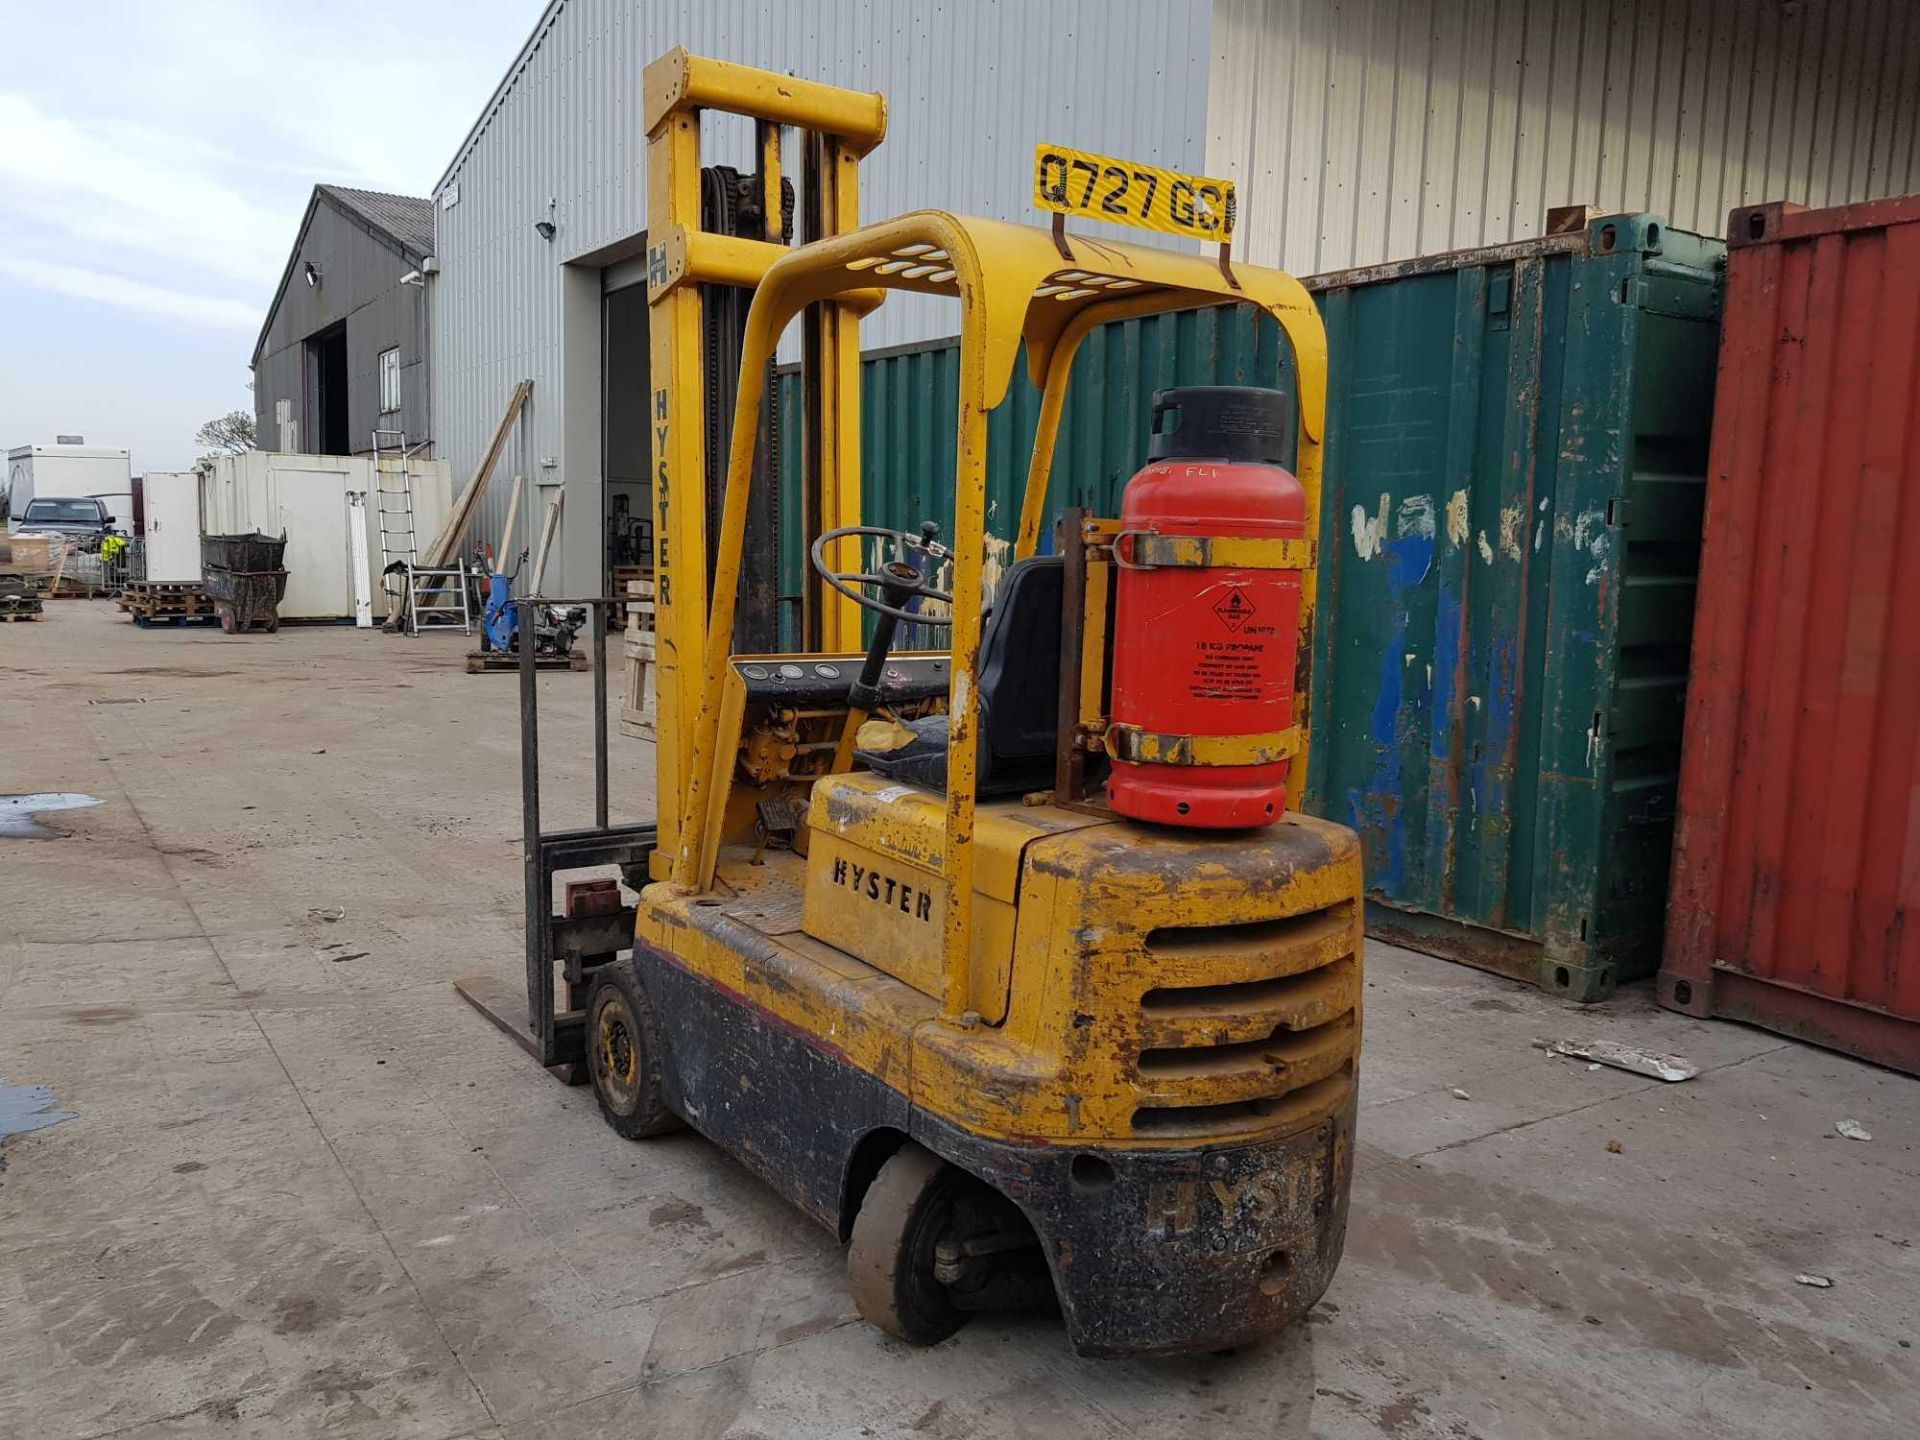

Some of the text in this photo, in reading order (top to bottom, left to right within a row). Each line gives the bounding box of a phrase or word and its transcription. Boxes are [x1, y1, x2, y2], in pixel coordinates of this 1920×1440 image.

[1041, 154, 1158, 217] Q727
[655, 389, 671, 606] HYSTER
[833, 859, 931, 922] HYSTER
